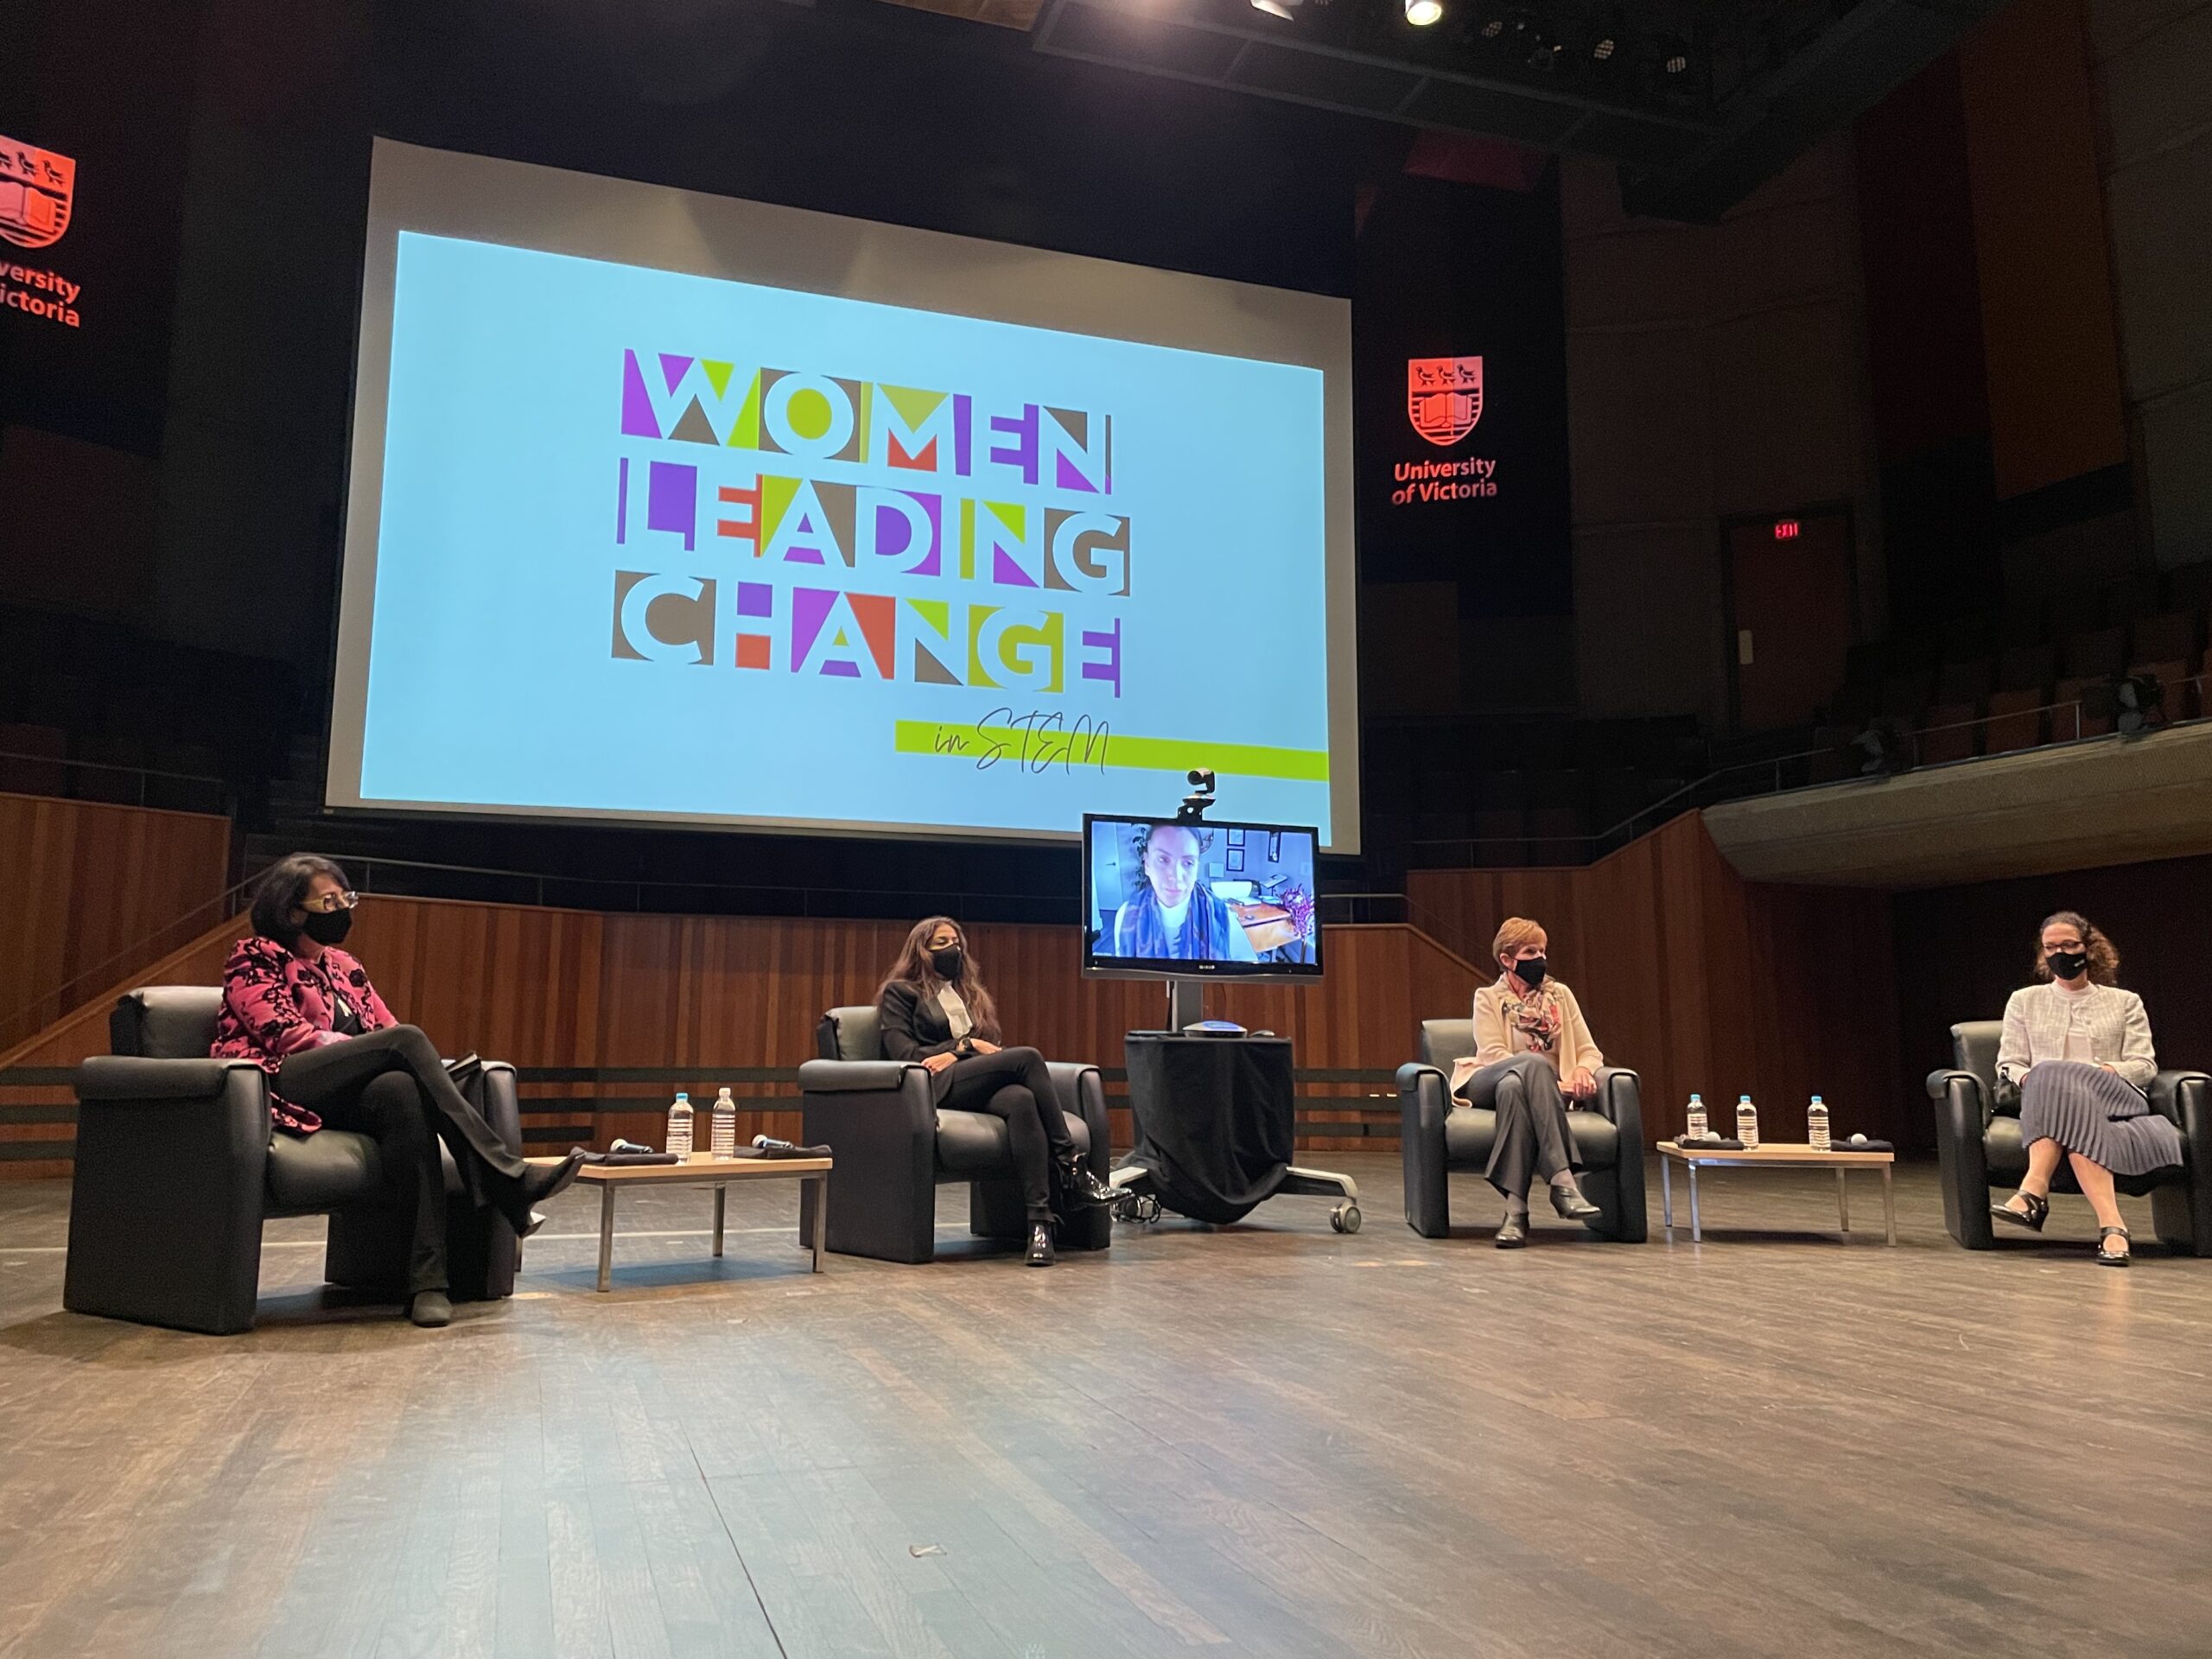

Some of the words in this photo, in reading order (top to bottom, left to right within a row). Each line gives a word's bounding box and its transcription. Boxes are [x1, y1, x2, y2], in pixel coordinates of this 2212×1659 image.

[621, 348, 1112, 495] WOMEN
[1391, 482, 1415, 505] of
[1418, 479, 1498, 503] Victoria
[1394, 457, 1497, 482] University
[617, 457, 1131, 597] LEADING
[1775, 522, 1799, 539] EXIT
[612, 569, 1121, 698] CHANGE
[935, 725, 969, 753] in
[976, 707, 1109, 776] STEM
